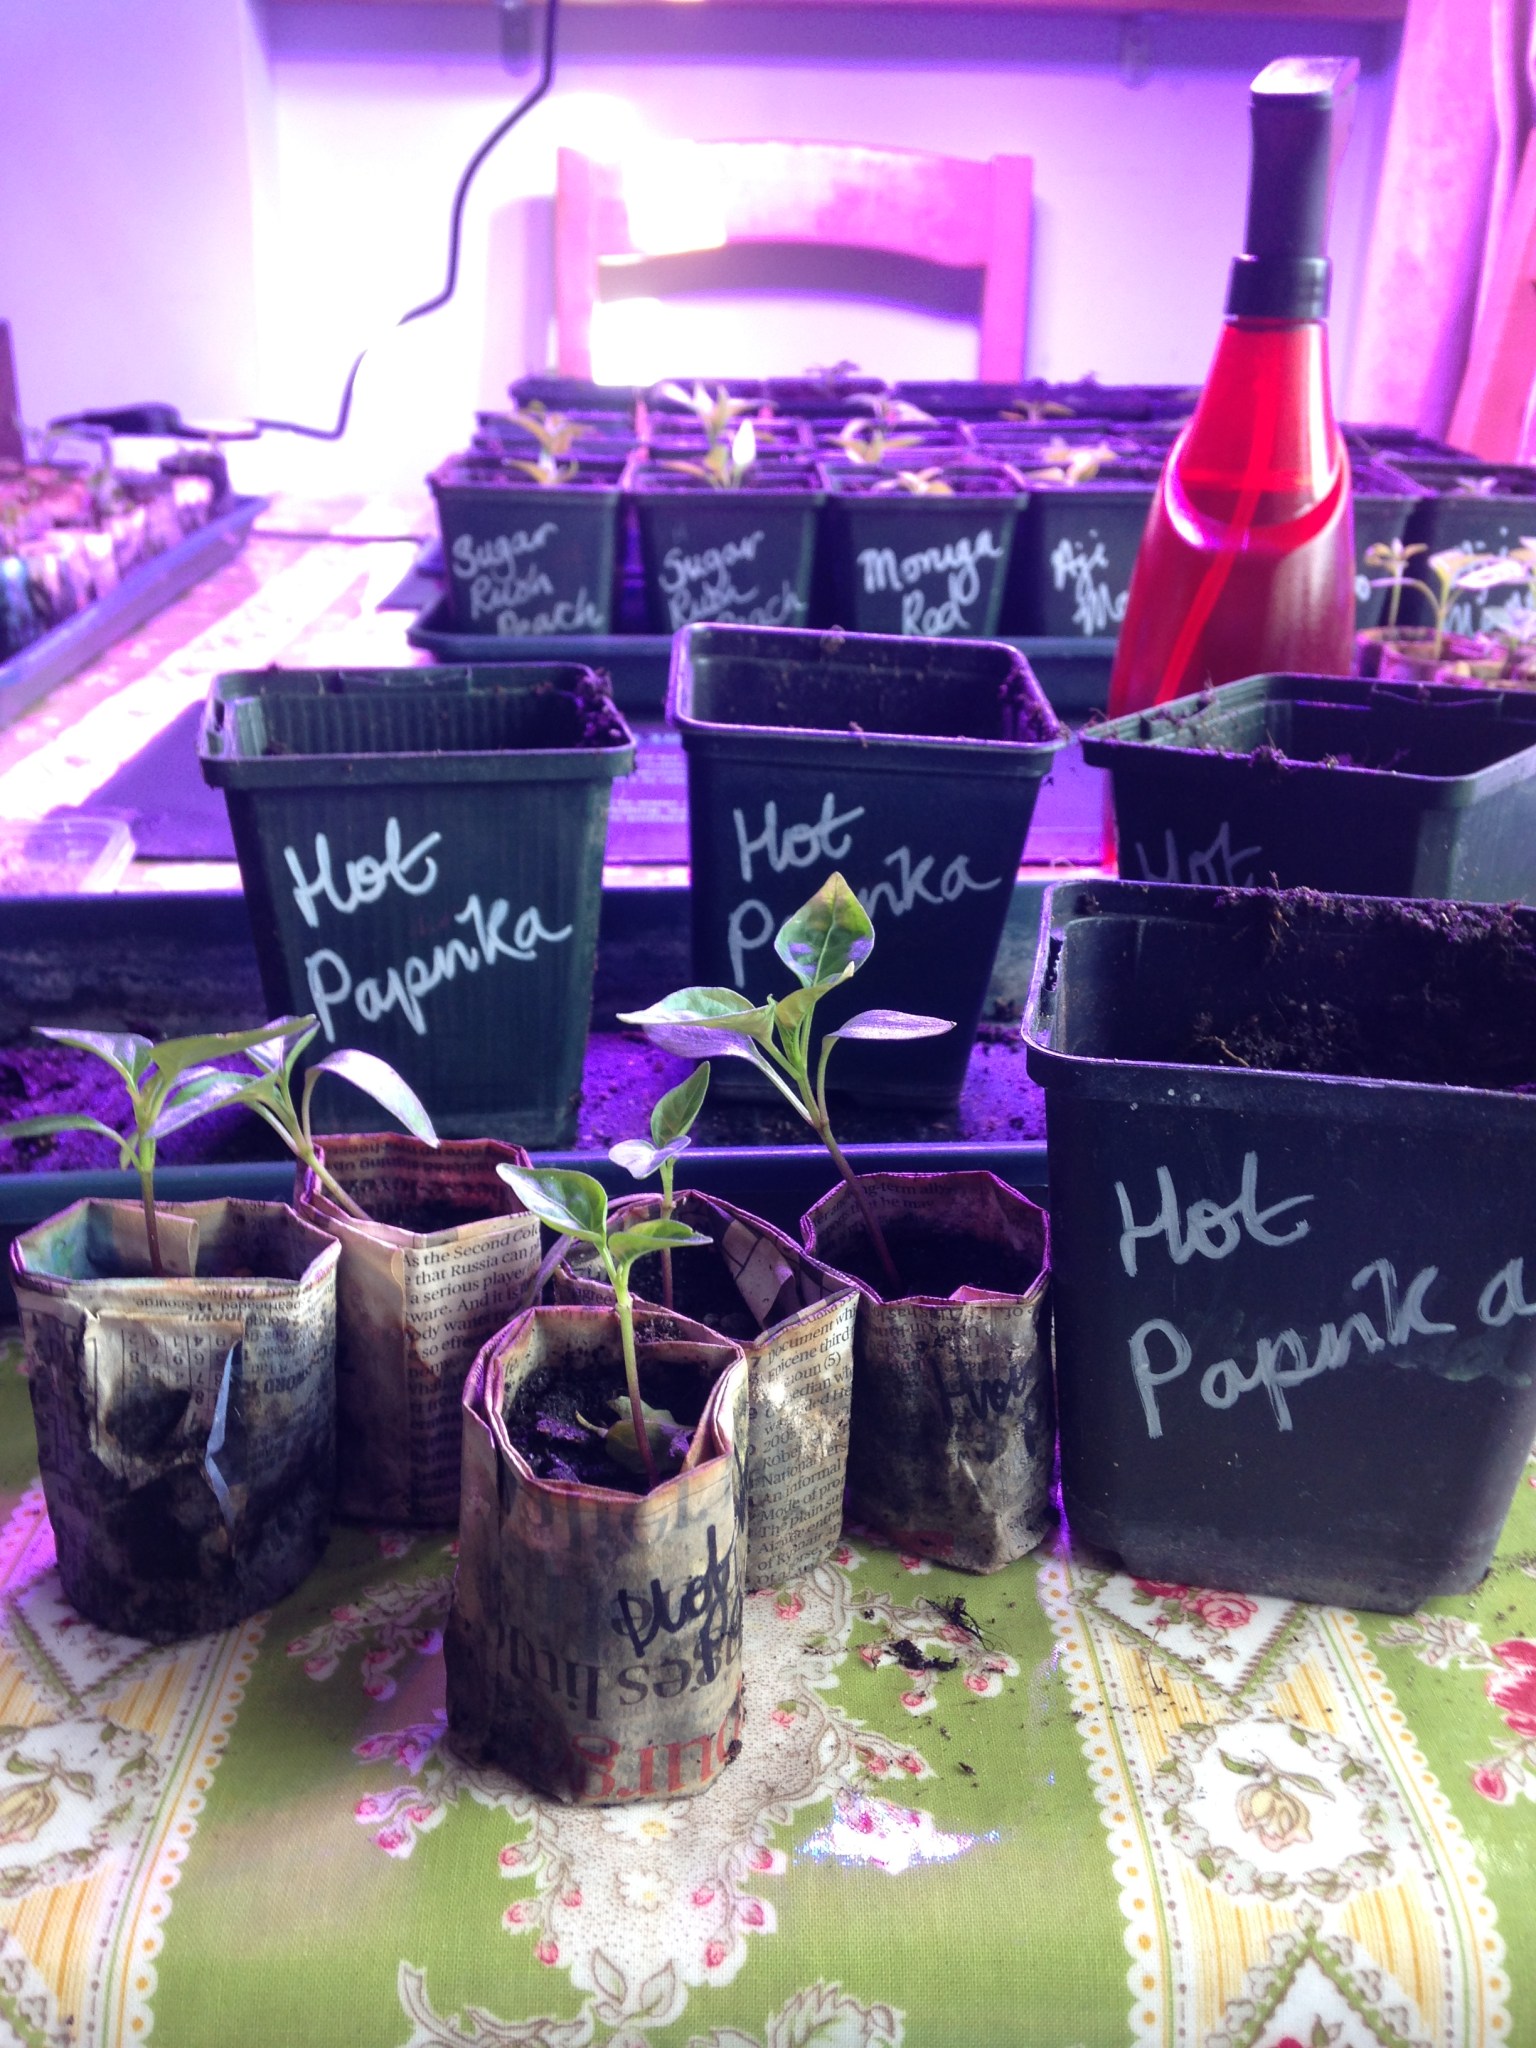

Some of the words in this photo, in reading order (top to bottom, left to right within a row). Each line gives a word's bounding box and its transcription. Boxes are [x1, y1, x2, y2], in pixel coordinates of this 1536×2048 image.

[452, 522, 561, 588] Sugar
[658, 530, 766, 593] Sugar
[733, 793, 865, 881] Hot
[283, 816, 440, 928] Hot
[727, 845, 1002, 988] Prika
[1114, 1150, 1315, 1277] Hot
[415, 1270, 446, 1287] that
[450, 1256, 499, 1278] Russia
[501, 1248, 529, 1264] can
[423, 1250, 451, 1266] the
[453, 1234, 511, 1260] Second
[406, 1304, 452, 1324] ware.
[456, 1294, 489, 1313] And
[492, 1289, 505, 1305] it
[423, 1279, 480, 1302] serious
[819, 1326, 851, 1353] third
[822, 1351, 842, 1371] (5)
[785, 1458, 841, 1498] informal
[759, 1520, 788, 1539] The
[789, 1504, 824, 1529] plain
[760, 1498, 802, 1522] Mode
[802, 1489, 818, 1505] of
[757, 1556, 773, 1571] of
